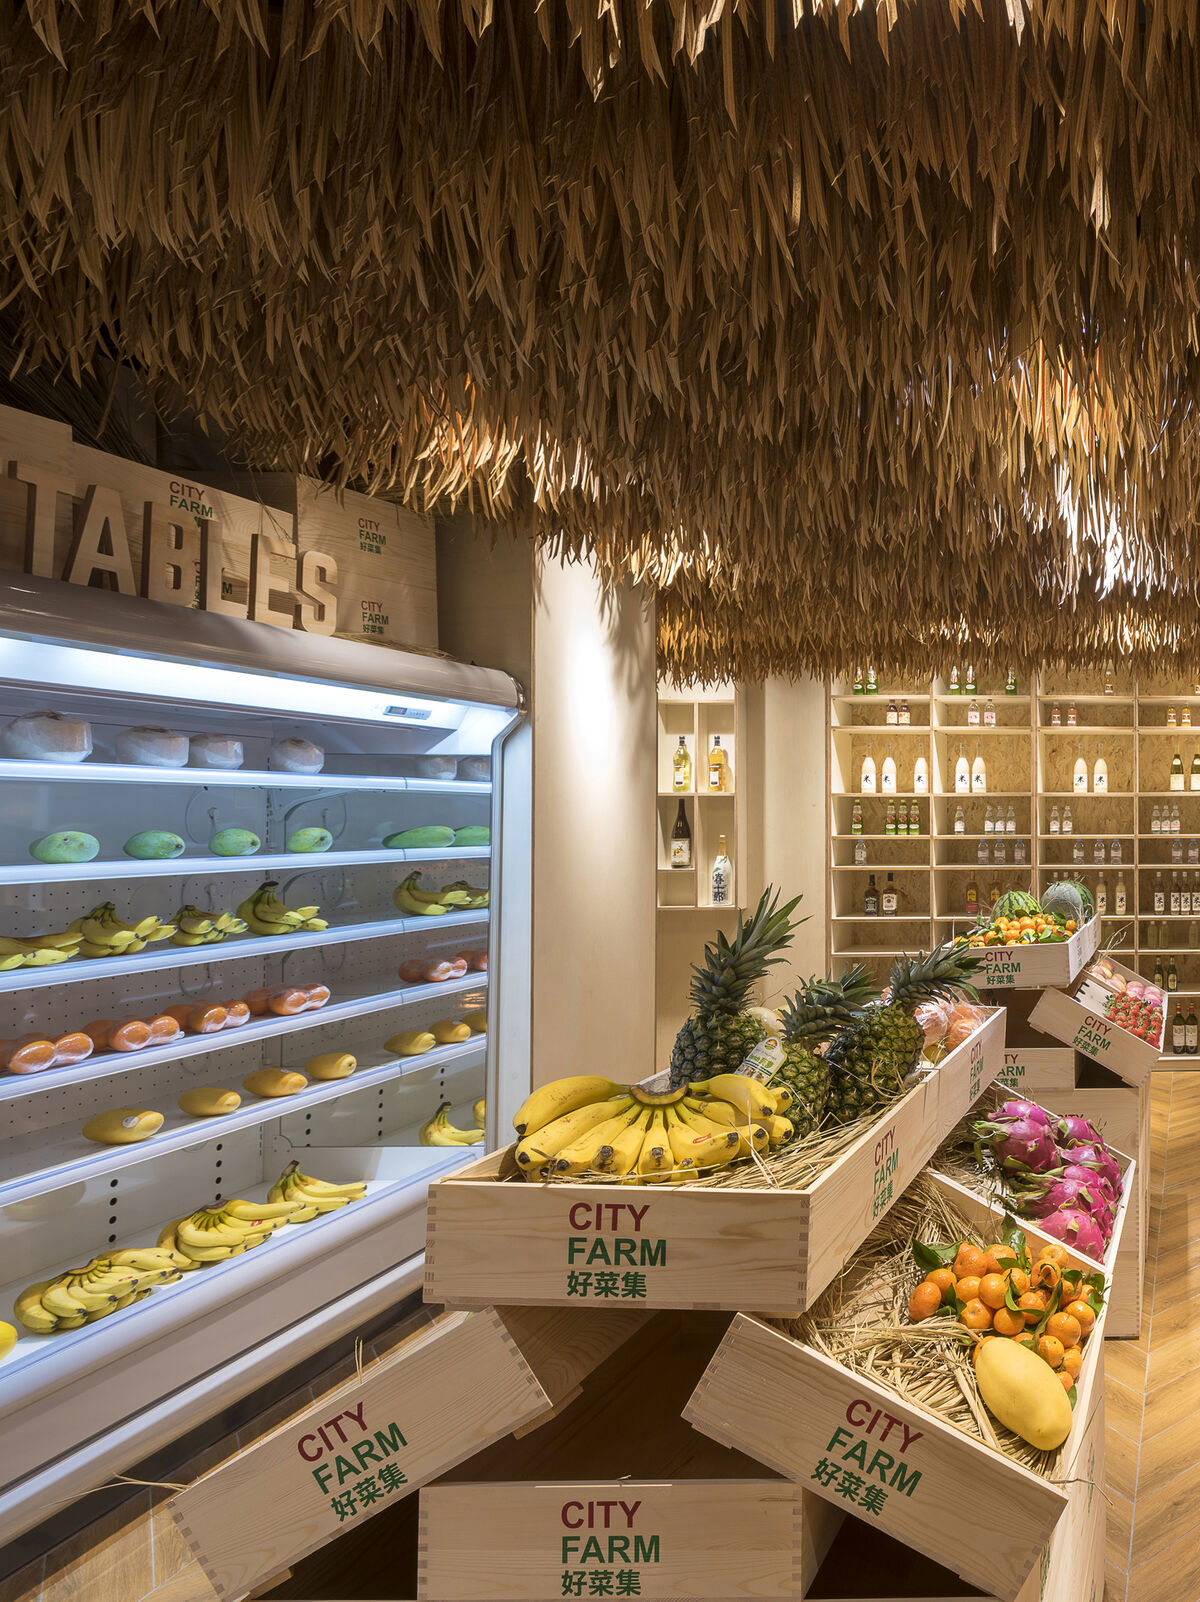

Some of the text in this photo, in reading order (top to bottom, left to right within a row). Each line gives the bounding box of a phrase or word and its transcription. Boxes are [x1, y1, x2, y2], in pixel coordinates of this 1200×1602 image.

[169, 481, 205, 500] CITY
[169, 495, 213, 518] FARM
[358, 518, 381, 532] CITY
[360, 529, 387, 545] FARM
[361, 600, 383, 613] CITY
[362, 611, 389, 625] FARM
[985, 951, 1014, 962] CITY
[985, 963, 1021, 974] FARM
[986, 974, 1015, 985] 好菜集
[1077, 1025, 1111, 1051] FARM
[1084, 1015, 1112, 1036] CITY
[997, 1066, 1025, 1076] ARM
[874, 1125, 895, 1166] CITY
[873, 1147, 899, 1194] FARM
[569, 1202, 650, 1231] CITY
[568, 1237, 666, 1266] FARM
[567, 1270, 647, 1298] 好菜集
[298, 1401, 368, 1462] CITY
[846, 1399, 924, 1453] CITY
[312, 1422, 408, 1495] FARM
[826, 1426, 923, 1497] FARM
[331, 1462, 408, 1522] 好菜集
[811, 1457, 889, 1516] 好菜集
[561, 1501, 642, 1529] CITY
[562, 1535, 660, 1563] FARM
[561, 1569, 641, 1597] 好菜集
